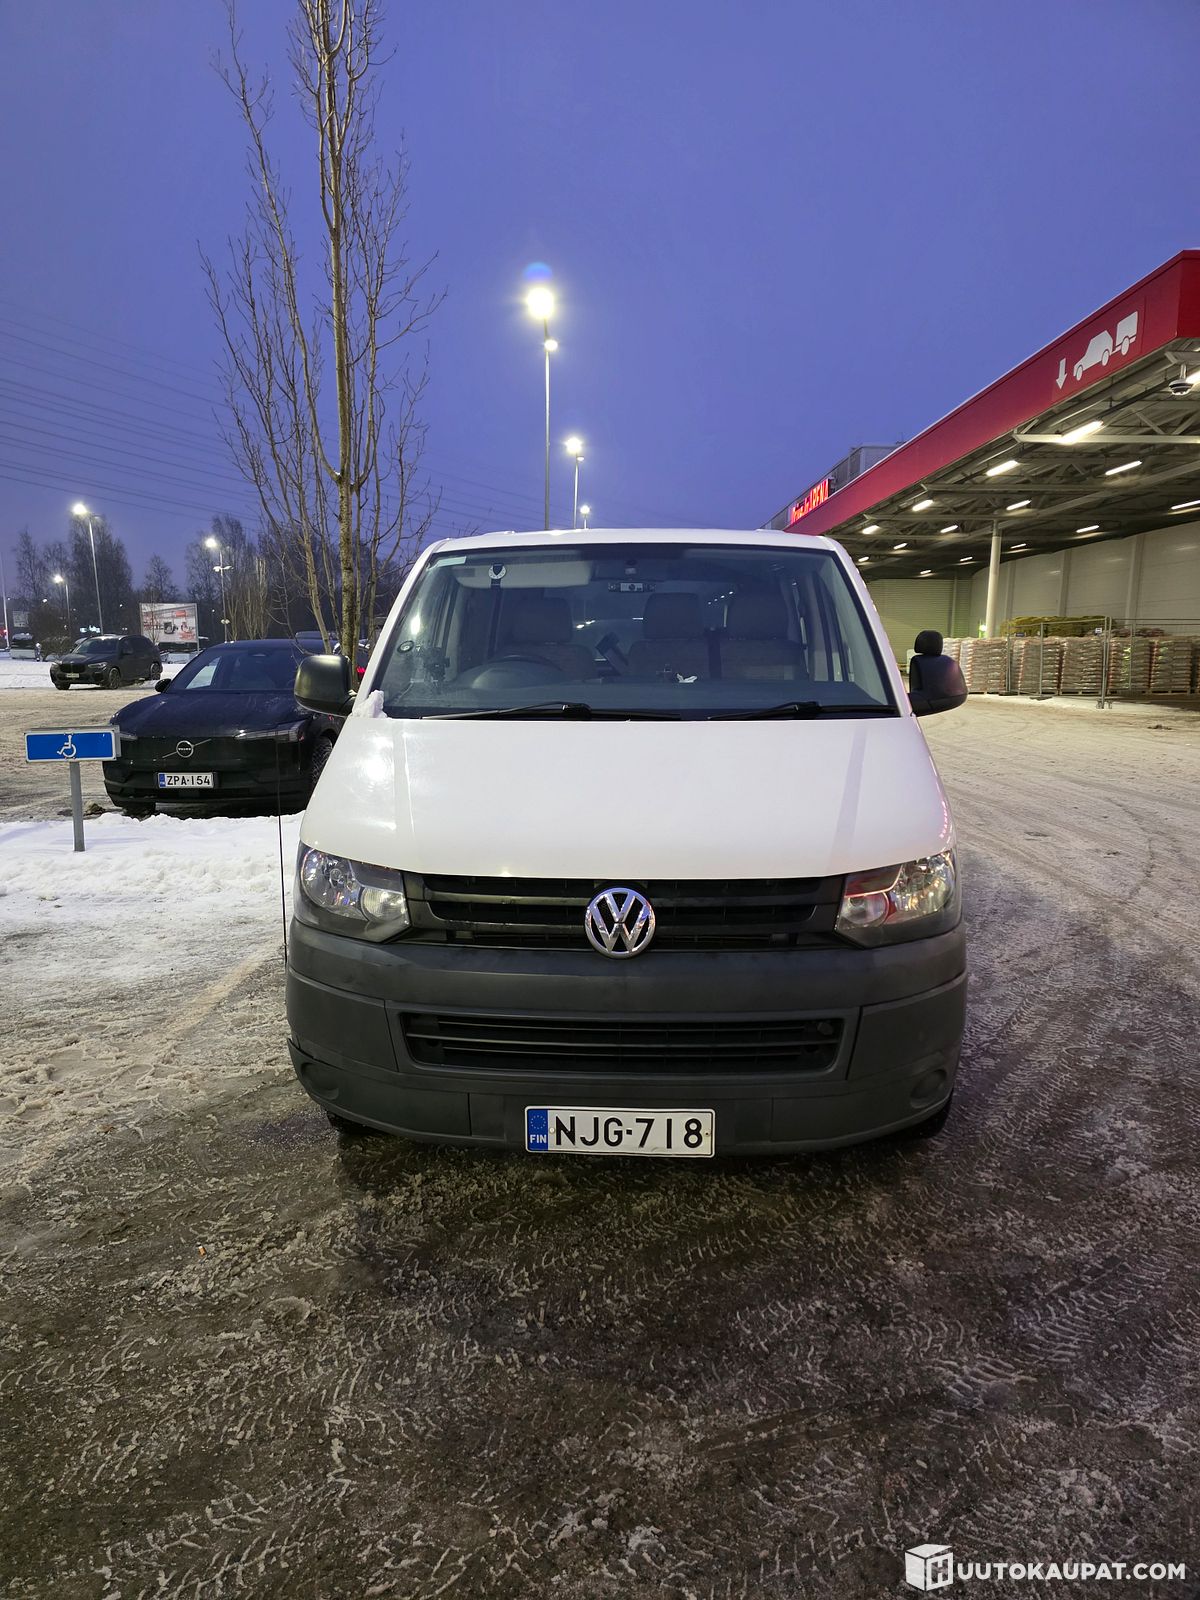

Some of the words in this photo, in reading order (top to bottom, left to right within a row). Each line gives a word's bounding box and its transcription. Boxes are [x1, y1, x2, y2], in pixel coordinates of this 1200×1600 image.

[166, 775, 211, 786] ZPA-154
[555, 1115, 703, 1150] NJG-718
[529, 1134, 547, 1144] FIN
